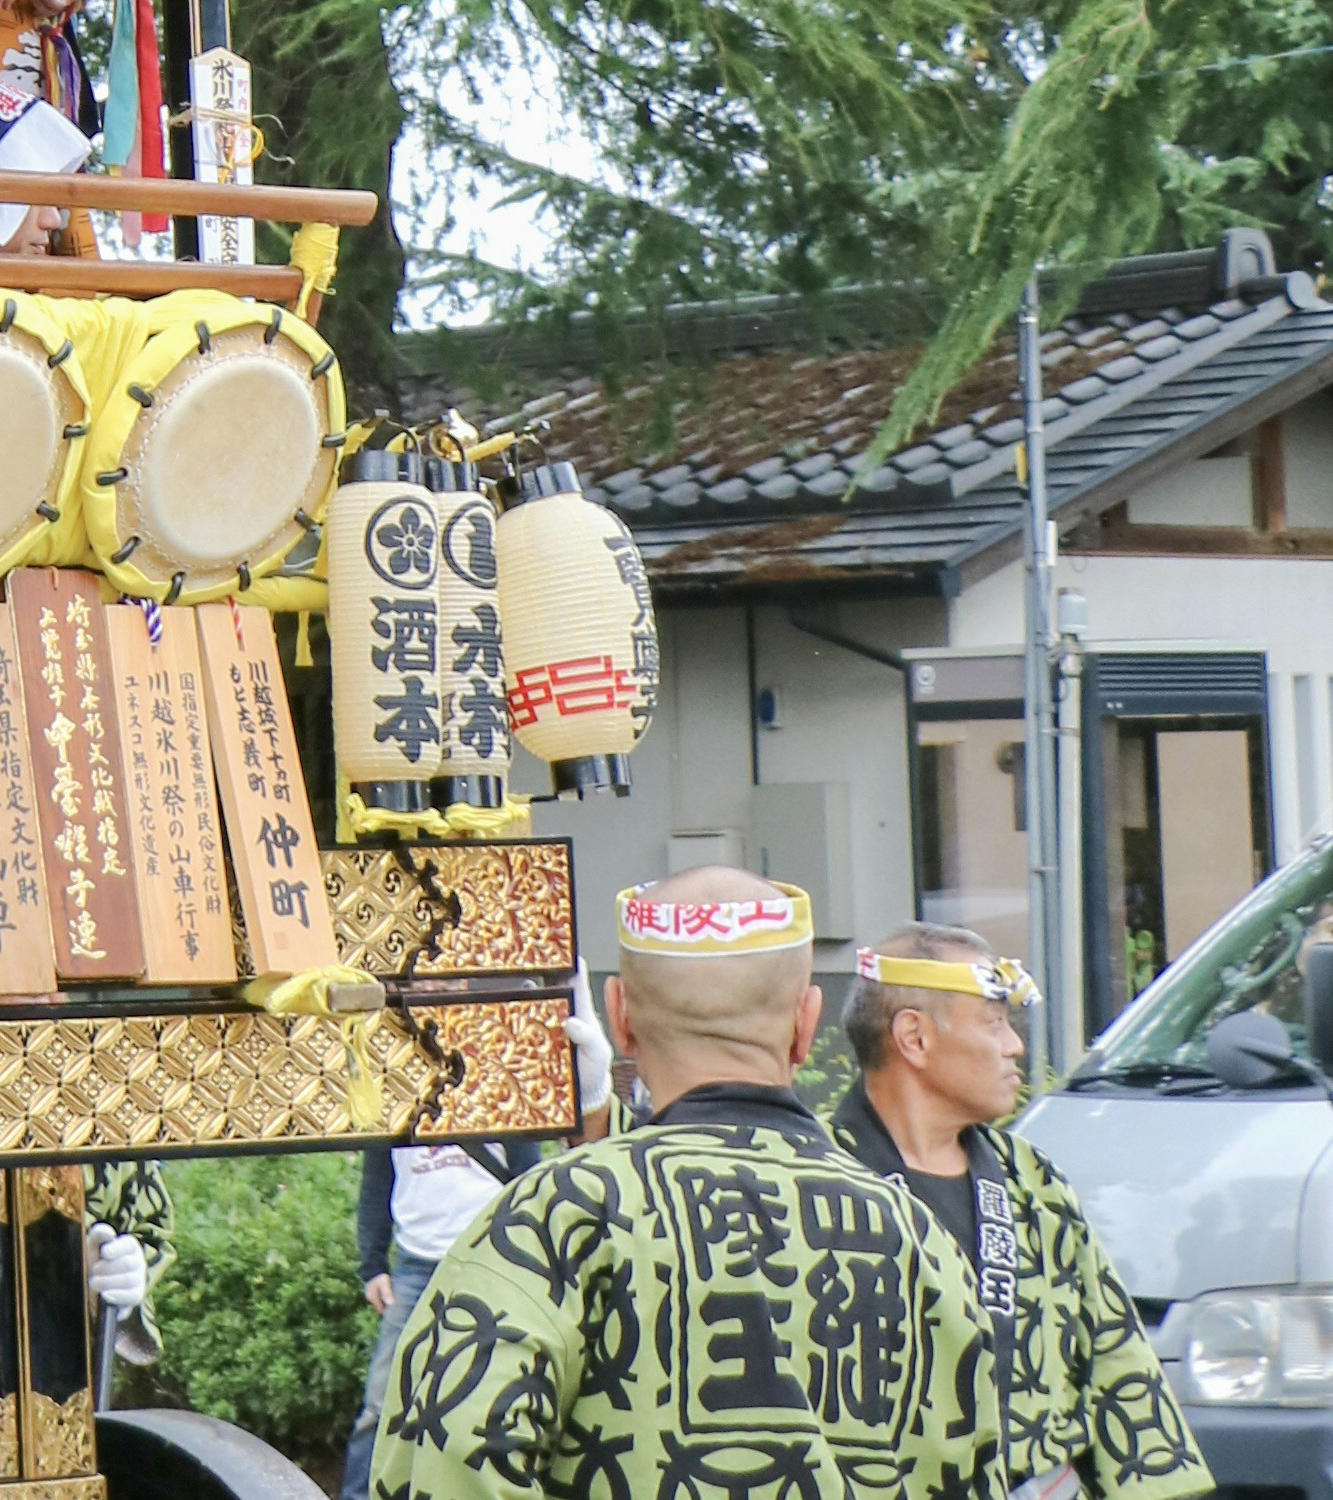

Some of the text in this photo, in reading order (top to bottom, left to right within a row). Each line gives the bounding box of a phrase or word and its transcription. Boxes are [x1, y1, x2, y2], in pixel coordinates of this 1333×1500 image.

[124, 674, 161, 877] ユネスコ無形文化遺産
[370, 597, 439, 763] 酒本
[148, 669, 199, 963] 川越氷川祭の山車行事
[179, 672, 222, 915] 国指定重要無形民俗文化財
[256, 811, 310, 931] 仲町
